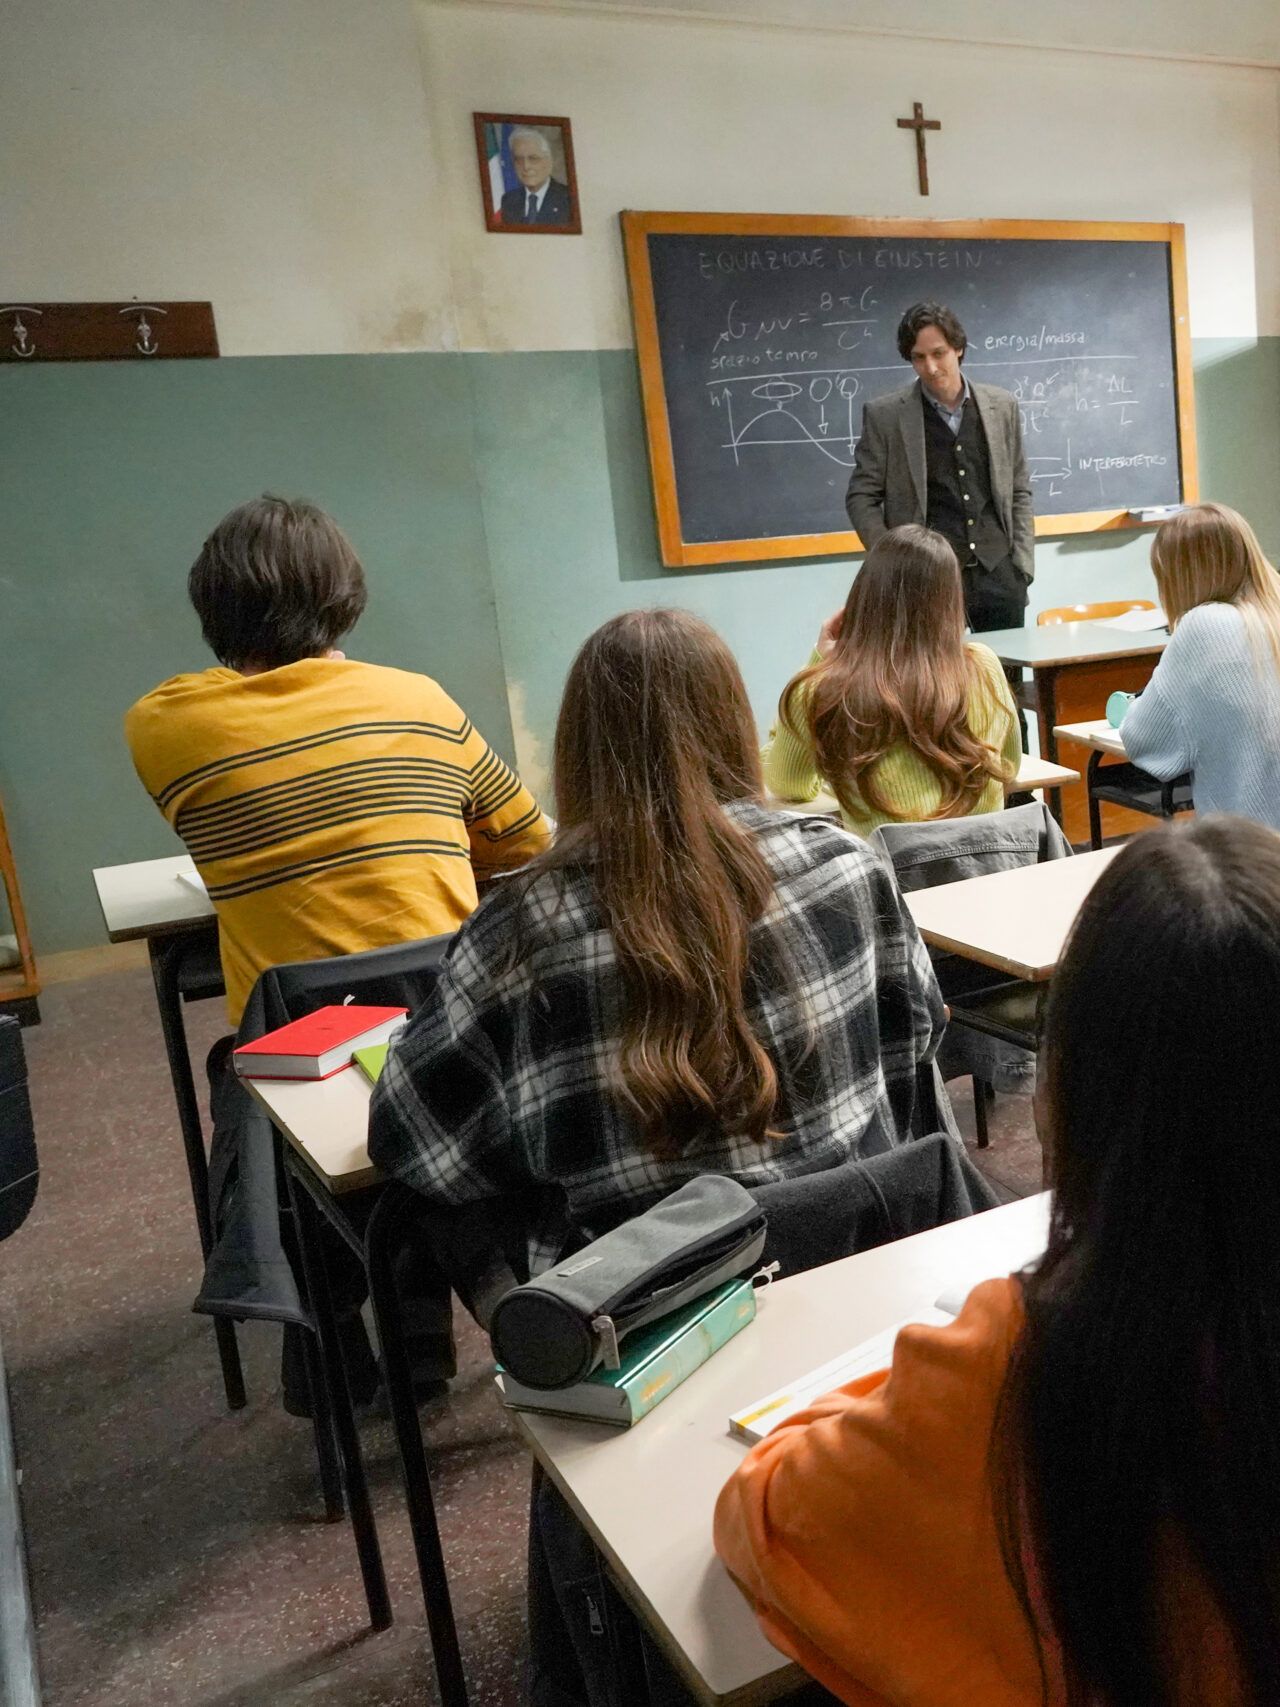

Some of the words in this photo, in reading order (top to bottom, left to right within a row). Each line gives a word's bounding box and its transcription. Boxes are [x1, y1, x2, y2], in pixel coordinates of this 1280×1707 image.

[698, 248, 826, 280] EQUAZIONE
[838, 249, 864, 269] DI
[874, 250, 983, 268] EINSTEIN
[984, 325, 1086, 352] energia/massa
[764, 347, 819, 364] tempo
